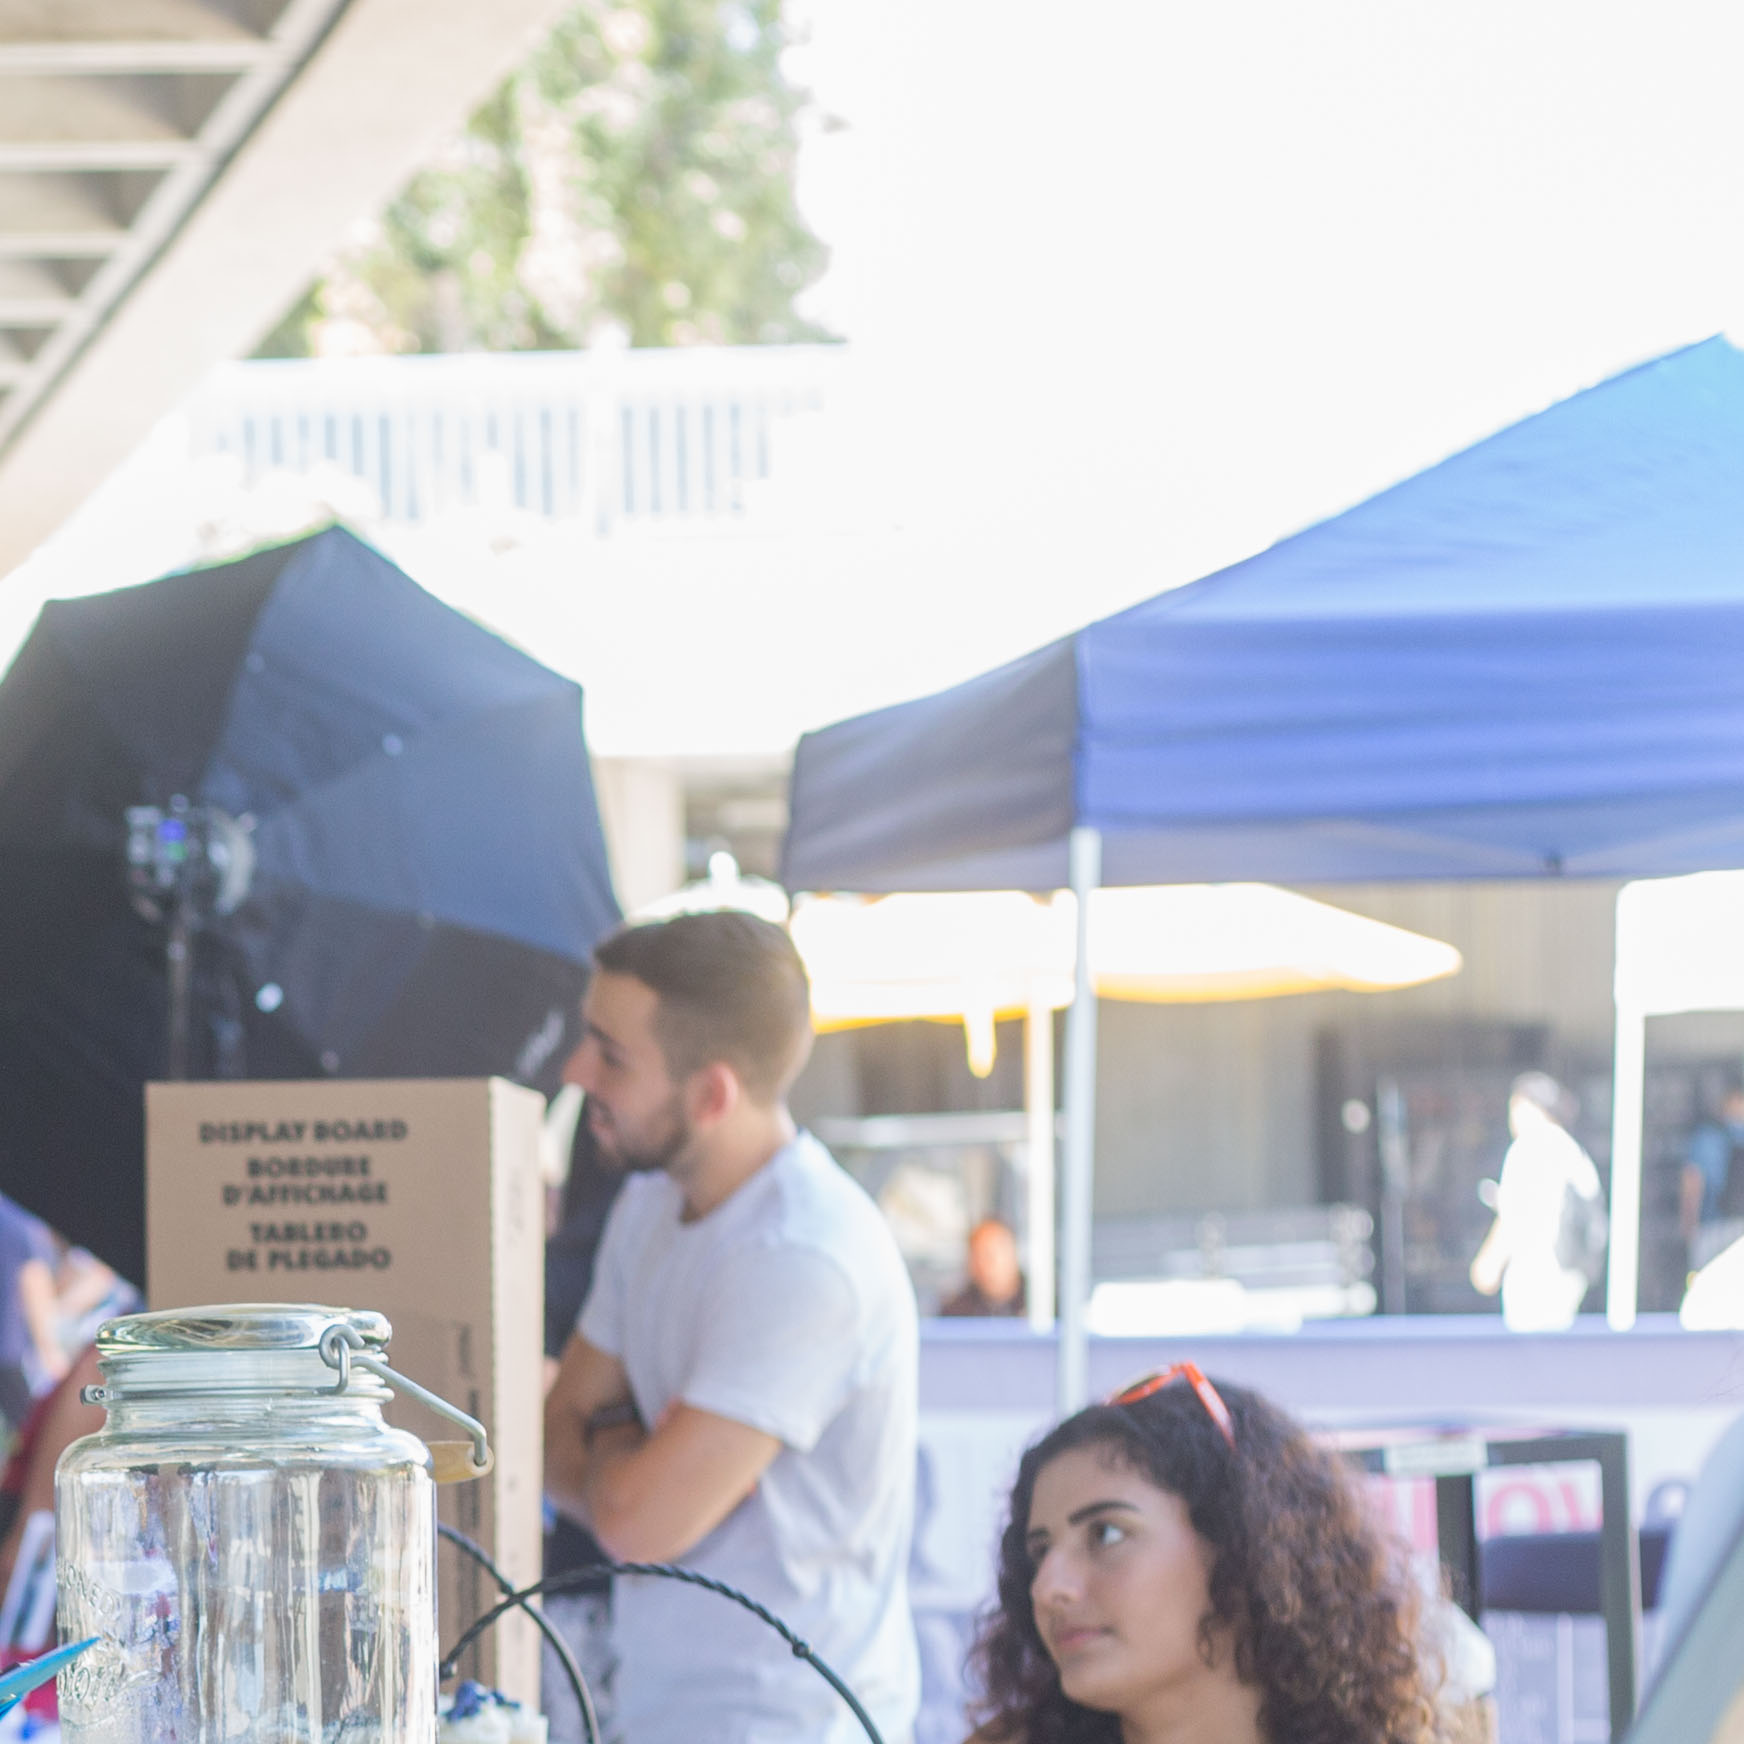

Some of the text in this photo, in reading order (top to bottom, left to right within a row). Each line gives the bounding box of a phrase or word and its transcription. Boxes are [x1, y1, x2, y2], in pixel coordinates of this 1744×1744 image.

[200, 1120, 407, 1143] DISPLAY BOARD
[248, 1157, 371, 1177] BORDURE
[223, 1183, 387, 1205] D'AFFICHAGE
[250, 1222, 367, 1243] TABLERO
[227, 1248, 391, 1271] DE PLEGADO
